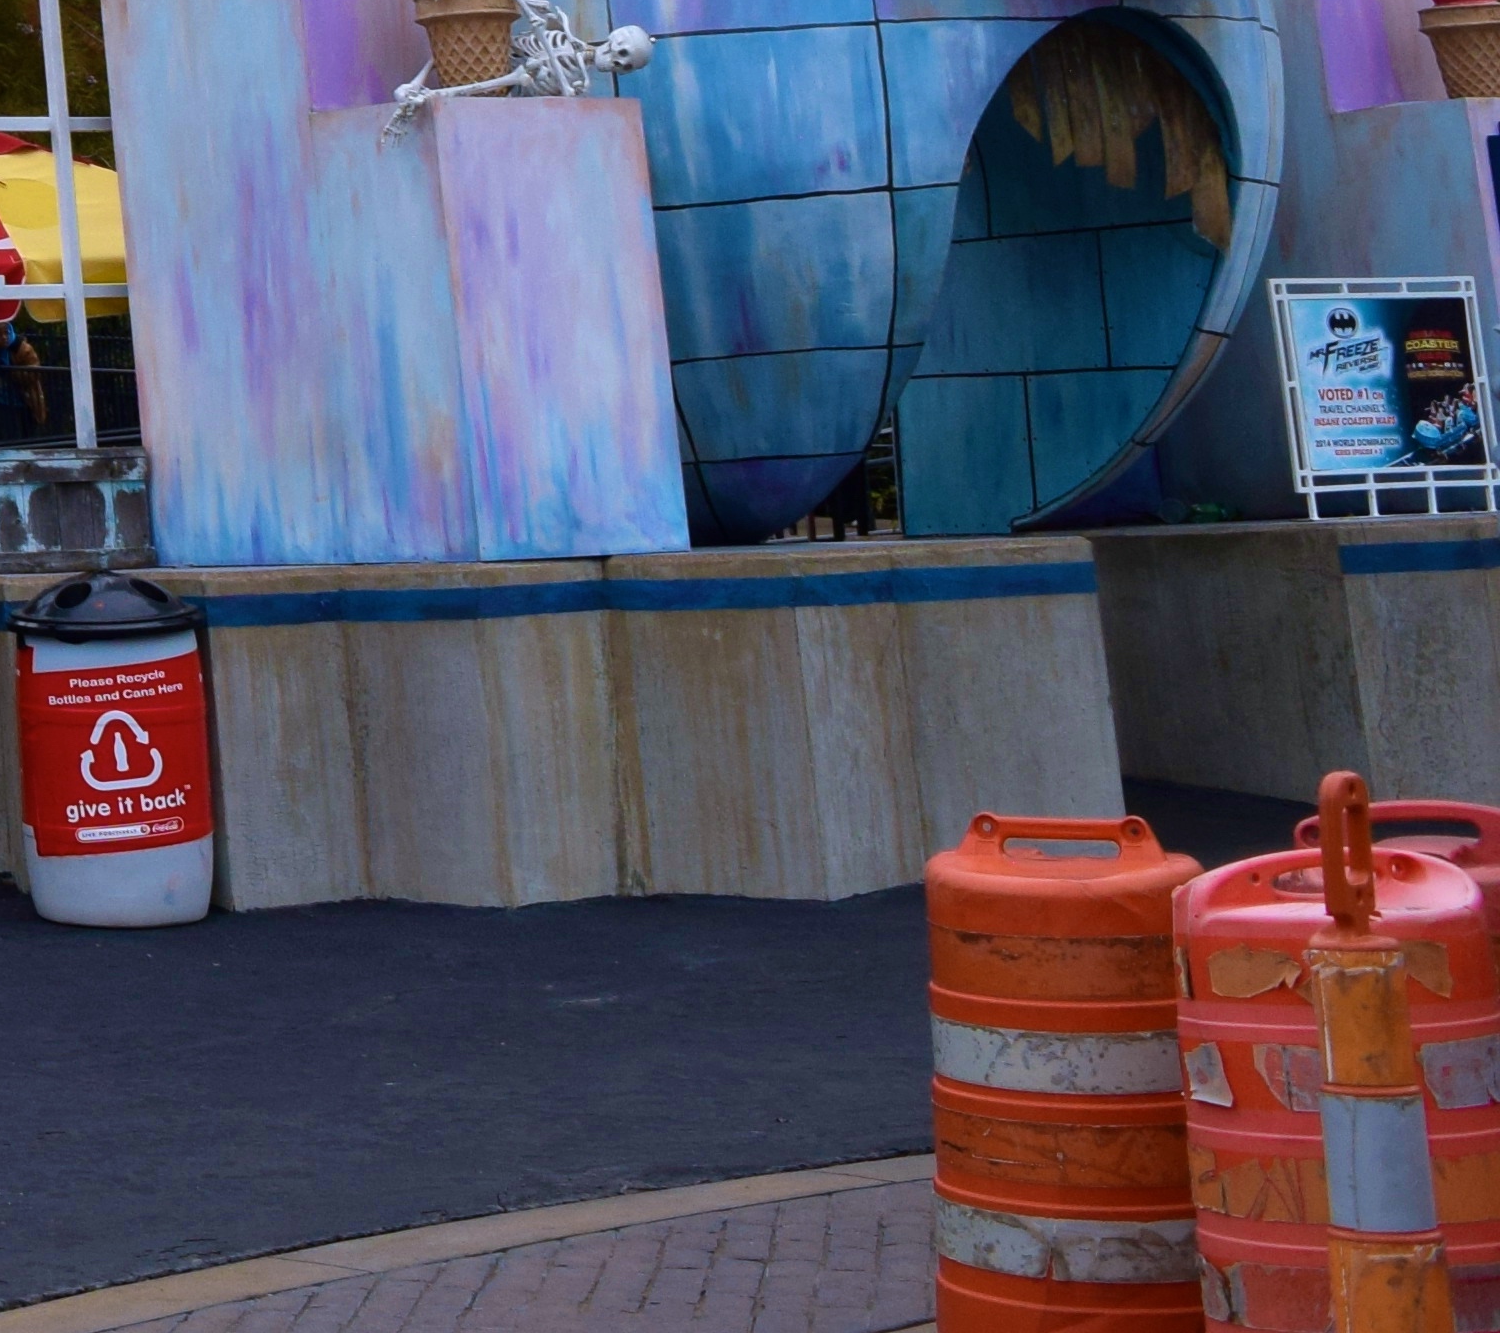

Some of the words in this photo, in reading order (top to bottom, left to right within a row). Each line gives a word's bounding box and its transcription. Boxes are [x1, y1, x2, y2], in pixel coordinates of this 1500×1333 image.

[1318, 387, 1353, 401] VOTED
[69, 675, 114, 688] Please
[116, 669, 166, 685] Recycle
[48, 695, 92, 706] Bottles
[94, 690, 120, 703] and
[122, 687, 156, 700] Cans
[158, 682, 184, 695] Here
[66, 799, 111, 823] give
[118, 796, 134, 815] it
[140, 788, 187, 813] back
